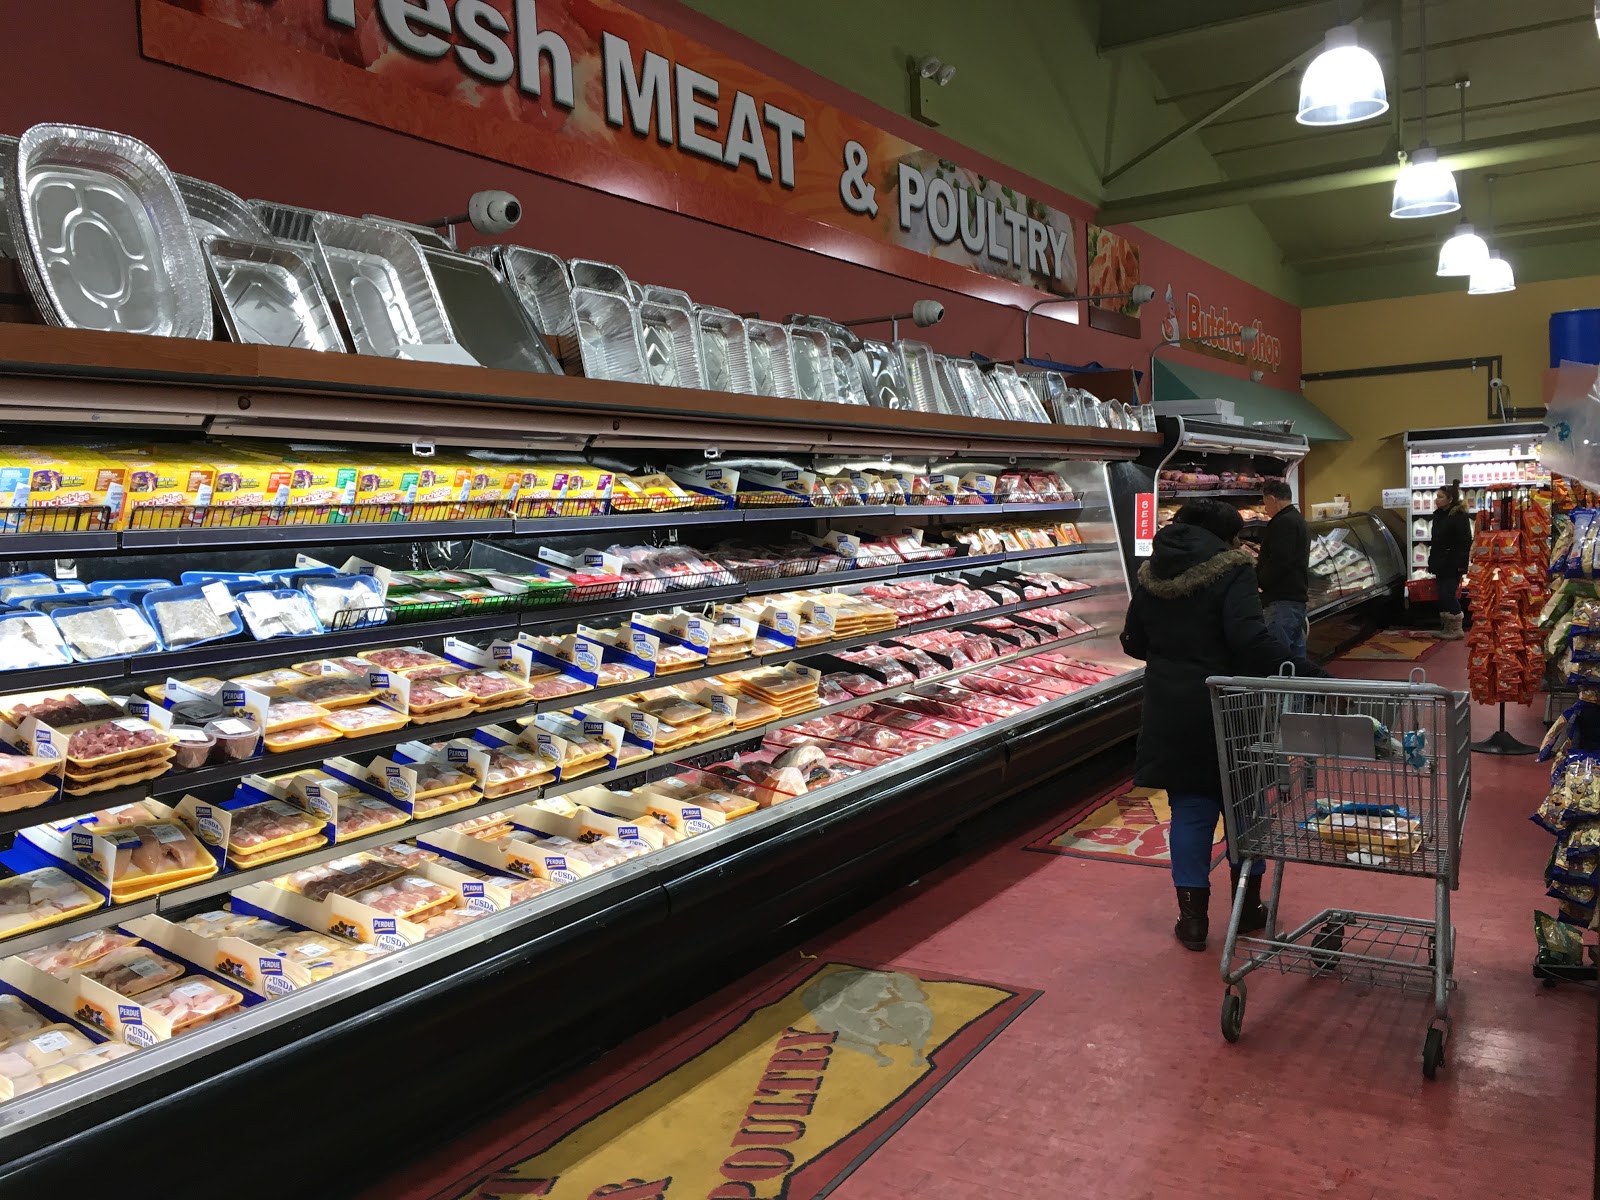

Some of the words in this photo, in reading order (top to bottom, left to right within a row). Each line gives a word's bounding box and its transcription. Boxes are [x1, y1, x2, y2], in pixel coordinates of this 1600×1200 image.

[602, 31, 806, 189] MEAT
[840, 140, 879, 217] &
[898, 163, 1068, 281] POULTRY
[33, 492, 90, 507] Lunchables
[132, 494, 183, 507] Lunchables
[217, 494, 263, 506] Lunchables
[292, 490, 332, 505] Lunchables
[1141, 501, 1149, 537] BEEF
[494, 647, 511, 655] PERDUE
[370, 674, 389, 682] PERDUE
[223, 691, 244, 700] PERDUE
[130, 706, 148, 714] PERDUE
[36, 731, 50, 739] PERDUE
[693, 820, 711, 830] USDA
[73, 835, 92, 846] PERDUE
[557, 871, 577, 881] USDA
[474, 899, 494, 911] USDA
[374, 920, 395, 928] PERDUE
[386, 936, 405, 948] USDA
[260, 959, 281, 968] PERDUE
[272, 977, 293, 991] USDA
[119, 1007, 140, 1017] PERDUE
[132, 1026, 154, 1044] USDA
